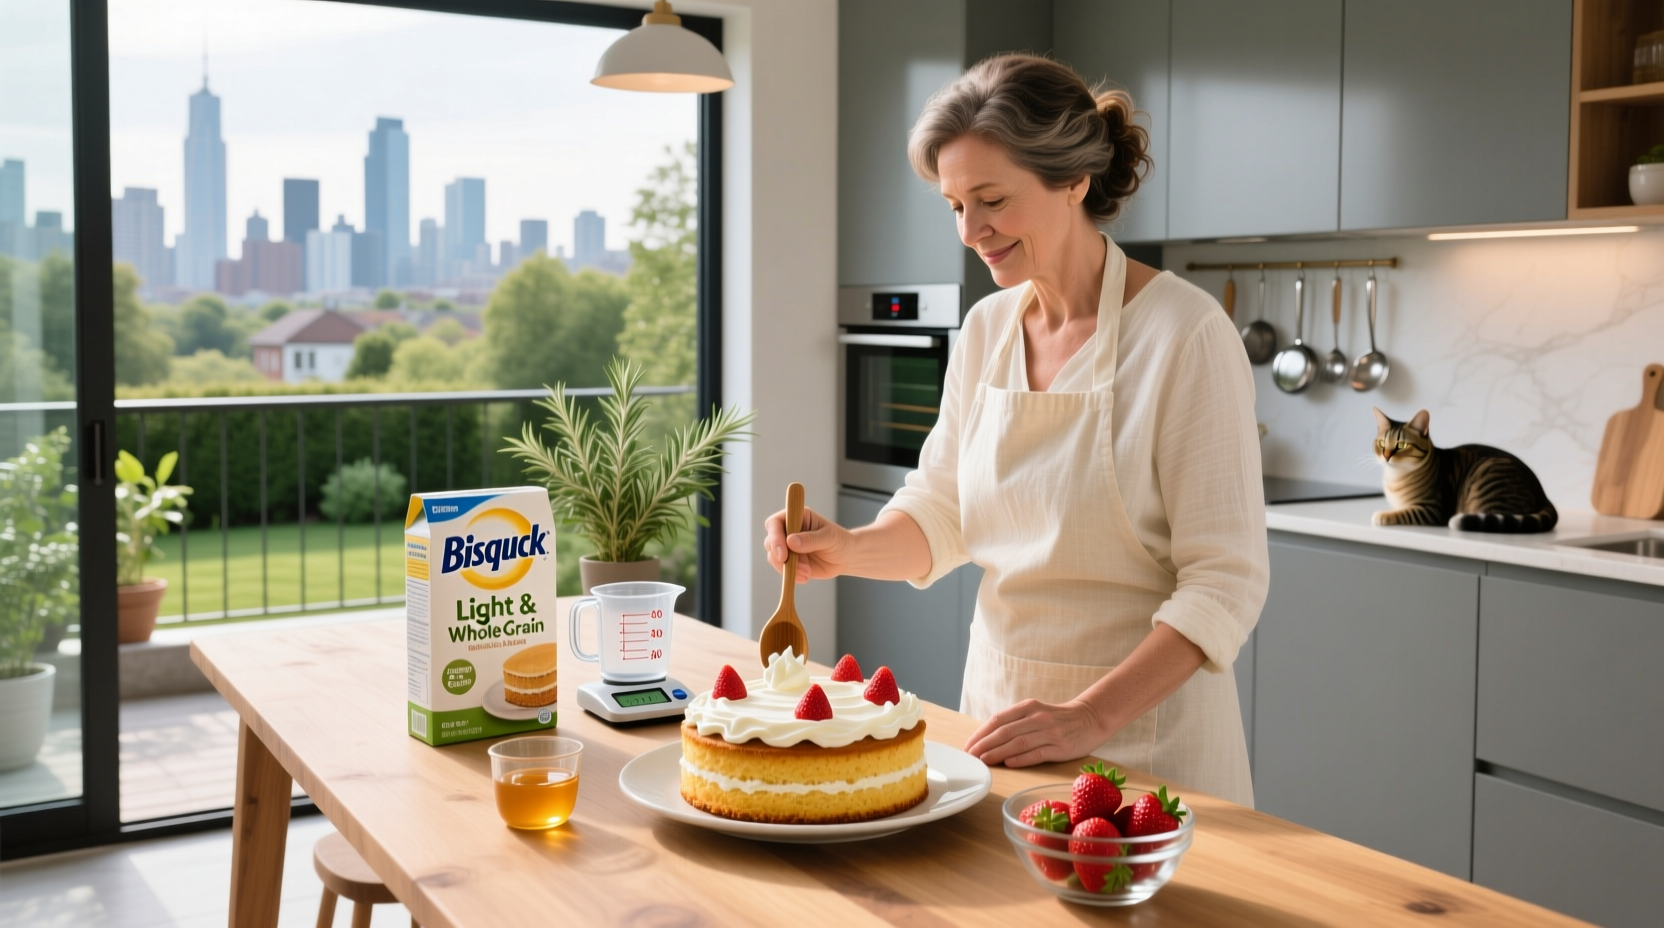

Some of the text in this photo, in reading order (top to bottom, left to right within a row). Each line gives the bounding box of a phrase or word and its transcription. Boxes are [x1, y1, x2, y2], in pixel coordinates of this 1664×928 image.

[441, 523, 546, 574] Bisquck
[456, 595, 514, 626] Light
[519, 593, 537, 615] &
